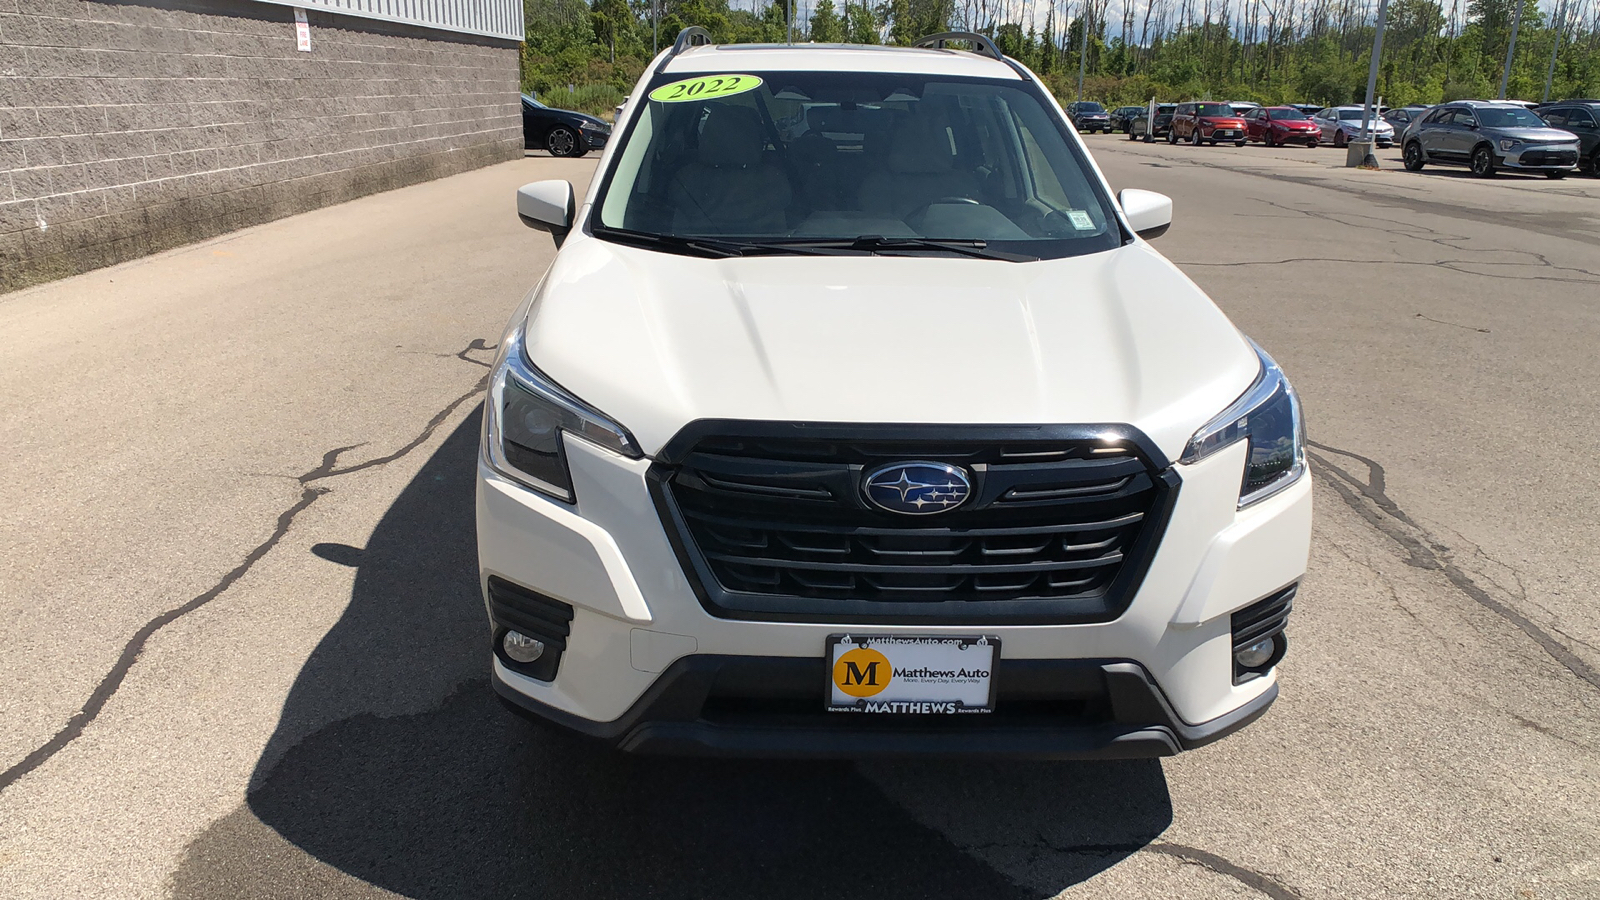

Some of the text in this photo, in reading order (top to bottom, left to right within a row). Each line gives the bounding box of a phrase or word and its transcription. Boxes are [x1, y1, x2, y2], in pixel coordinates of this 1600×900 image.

[667, 77, 741, 99] 2022
[866, 635, 963, 646] MatthewsAuto.com
[841, 661, 881, 686] M
[893, 667, 990, 678] Matthews Auto
[864, 701, 956, 714] MATTHEWS
